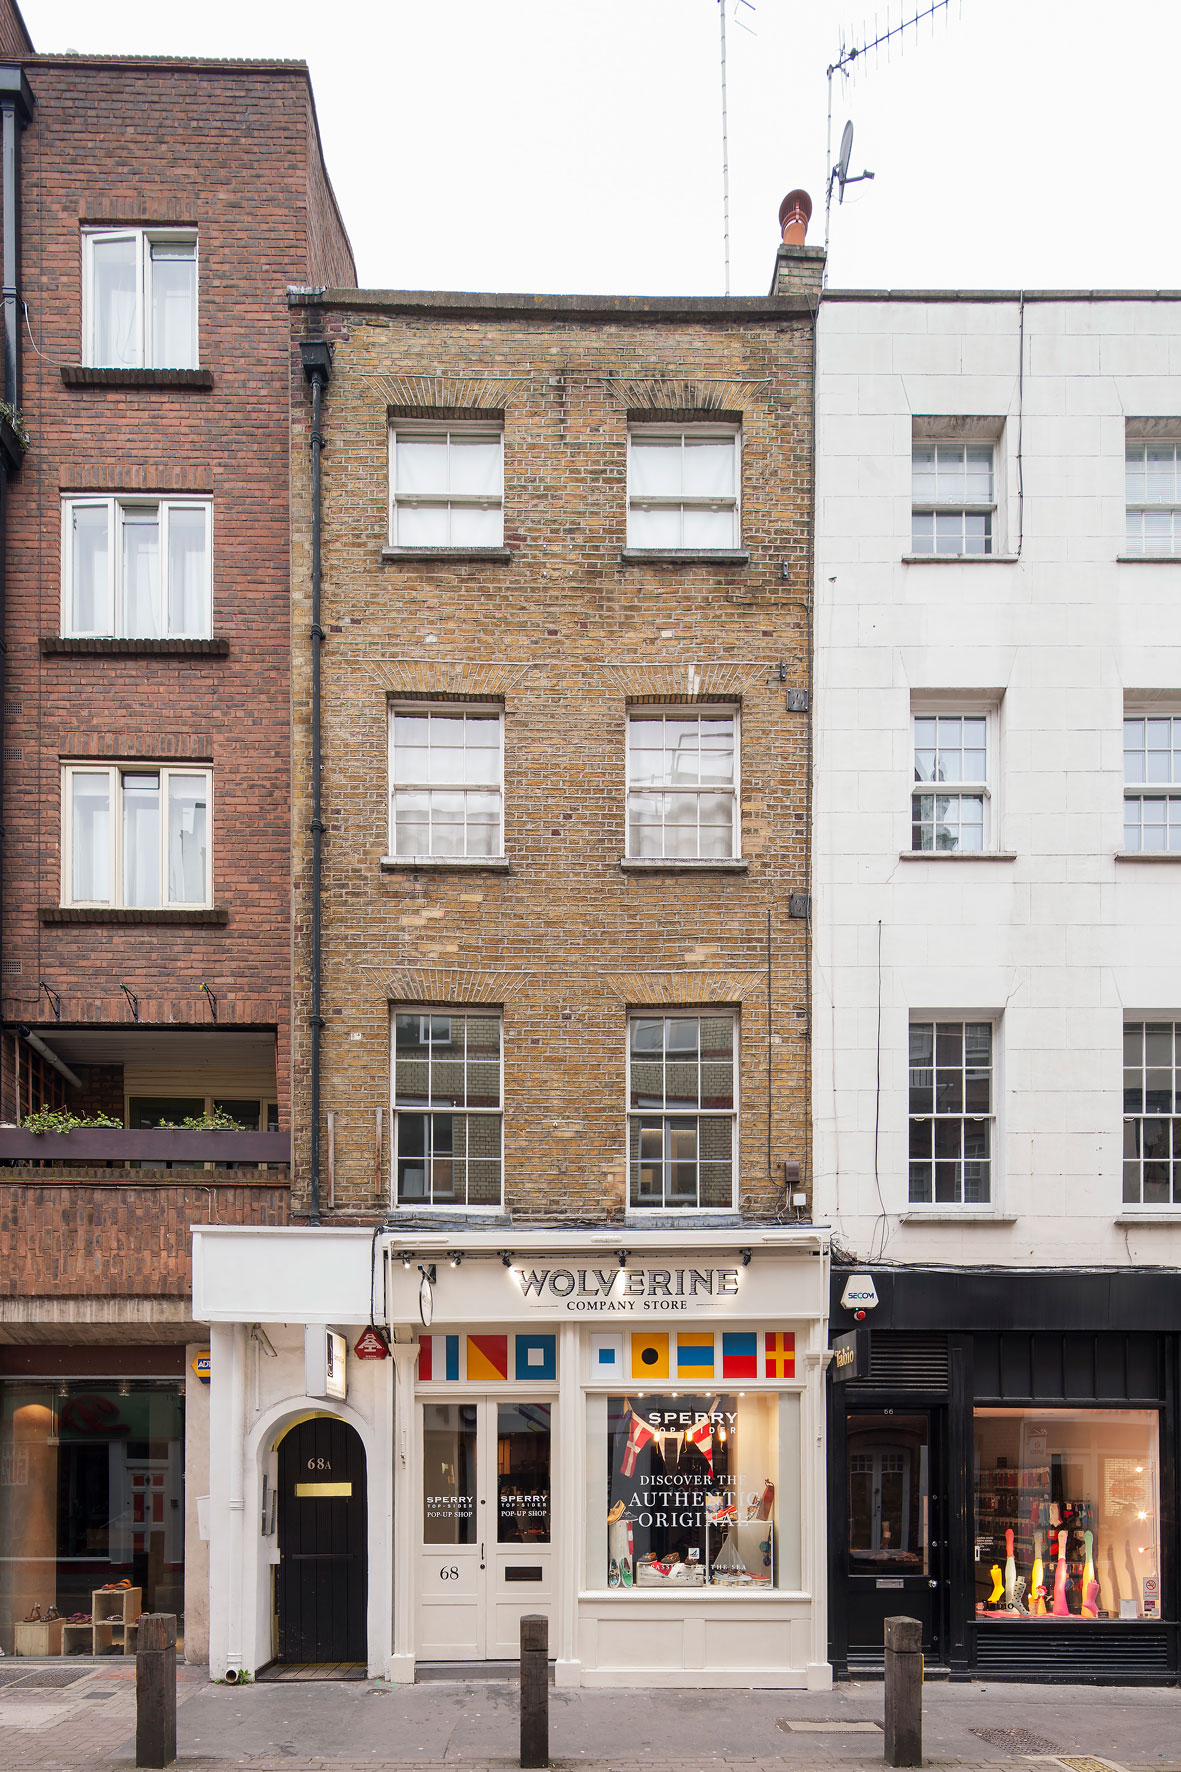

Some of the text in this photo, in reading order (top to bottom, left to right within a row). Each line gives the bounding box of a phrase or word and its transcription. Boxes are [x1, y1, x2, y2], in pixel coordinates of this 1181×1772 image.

[514, 1269, 739, 1297] WOLVERINE
[567, 1300, 687, 1311] COMPANY STORE
[834, 1345, 854, 1368] Tabio
[648, 1412, 738, 1424] SPERRY
[307, 1457, 331, 1470] 68A
[640, 1475, 746, 1485] DISCOVER THE
[628, 1491, 759, 1507] AUTHENTIC
[639, 1512, 749, 1528] ORIGINAL
[440, 1565, 459, 1580] 68
